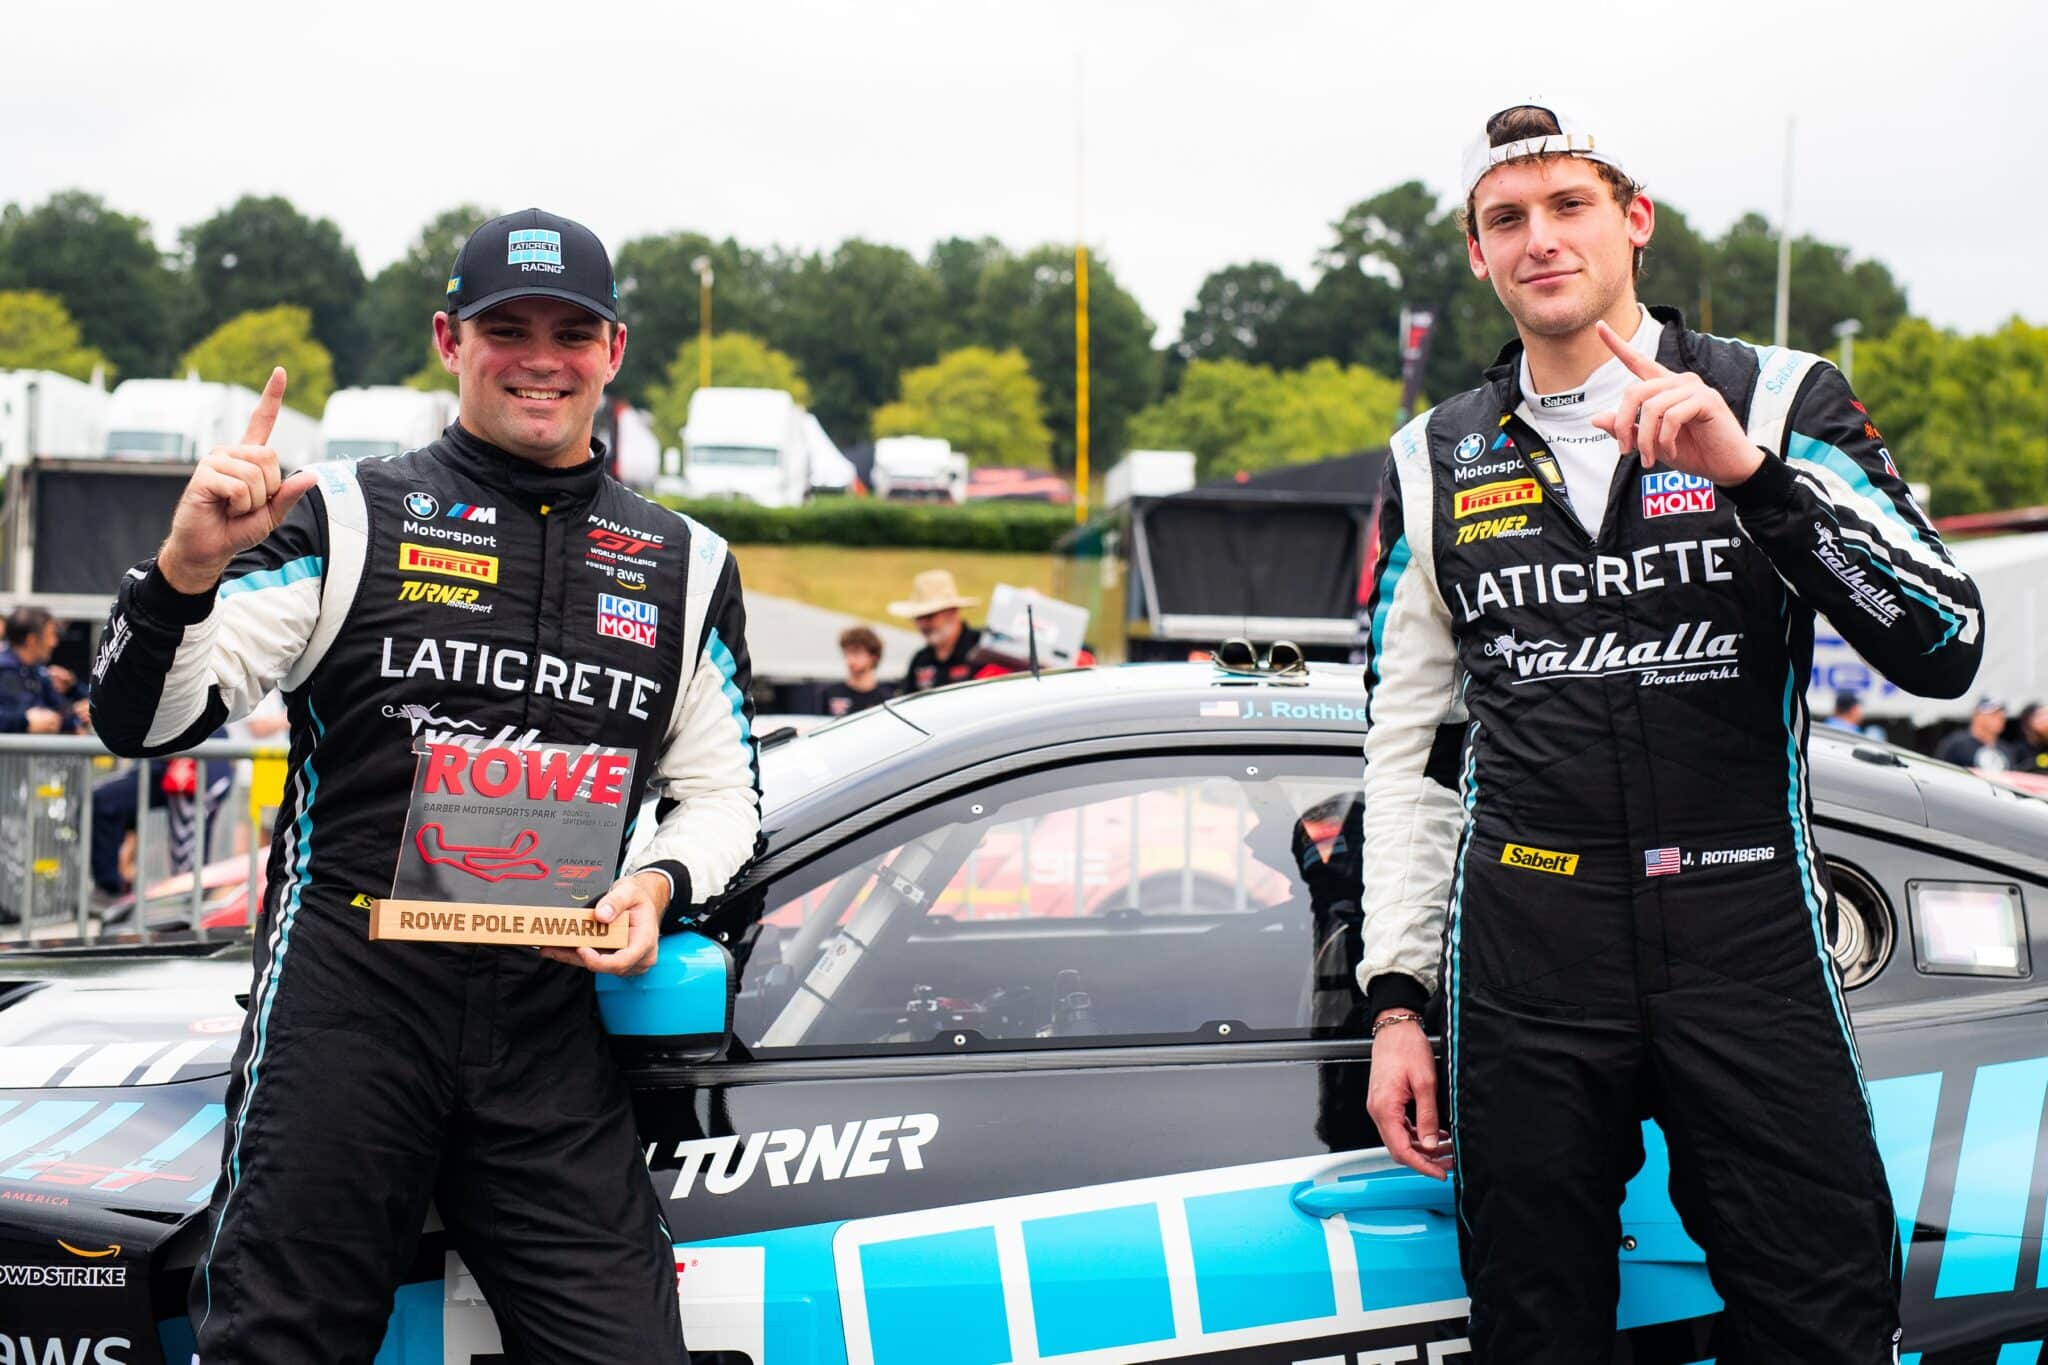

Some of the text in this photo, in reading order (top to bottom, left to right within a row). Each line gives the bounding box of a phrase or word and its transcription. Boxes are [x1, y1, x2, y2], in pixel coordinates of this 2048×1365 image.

[511, 243, 559, 252] LATICRETE
[521, 264, 562, 274] RACING
[1544, 393, 1581, 408] Sabelt
[1461, 483, 1535, 512] PIRELLI
[1645, 491, 1712, 516] MOLY
[403, 520, 497, 547] Motorsport
[588, 514, 665, 543] FANATEC
[1455, 515, 1528, 546] TURNER
[586, 529, 665, 555] GT
[409, 549, 490, 577] PIRELLI
[617, 568, 645, 584] aws
[398, 581, 480, 604] TURNER
[601, 596, 656, 625] LIQUI
[600, 615, 656, 645] MOLY
[1641, 665, 1740, 686] Boatworks
[1242, 701, 1263, 720] J.
[423, 744, 631, 804] ROWE
[423, 802, 557, 819] BARBER MOTORSPORTS PARK
[1509, 847, 1570, 872] Sabelt
[1681, 847, 1775, 866] J. ROTHBERG
[400, 911, 610, 938] ROWE POLE AWARD
[669, 1112, 940, 1200] TURNER
[2, 1190, 71, 1206] AMERICA
